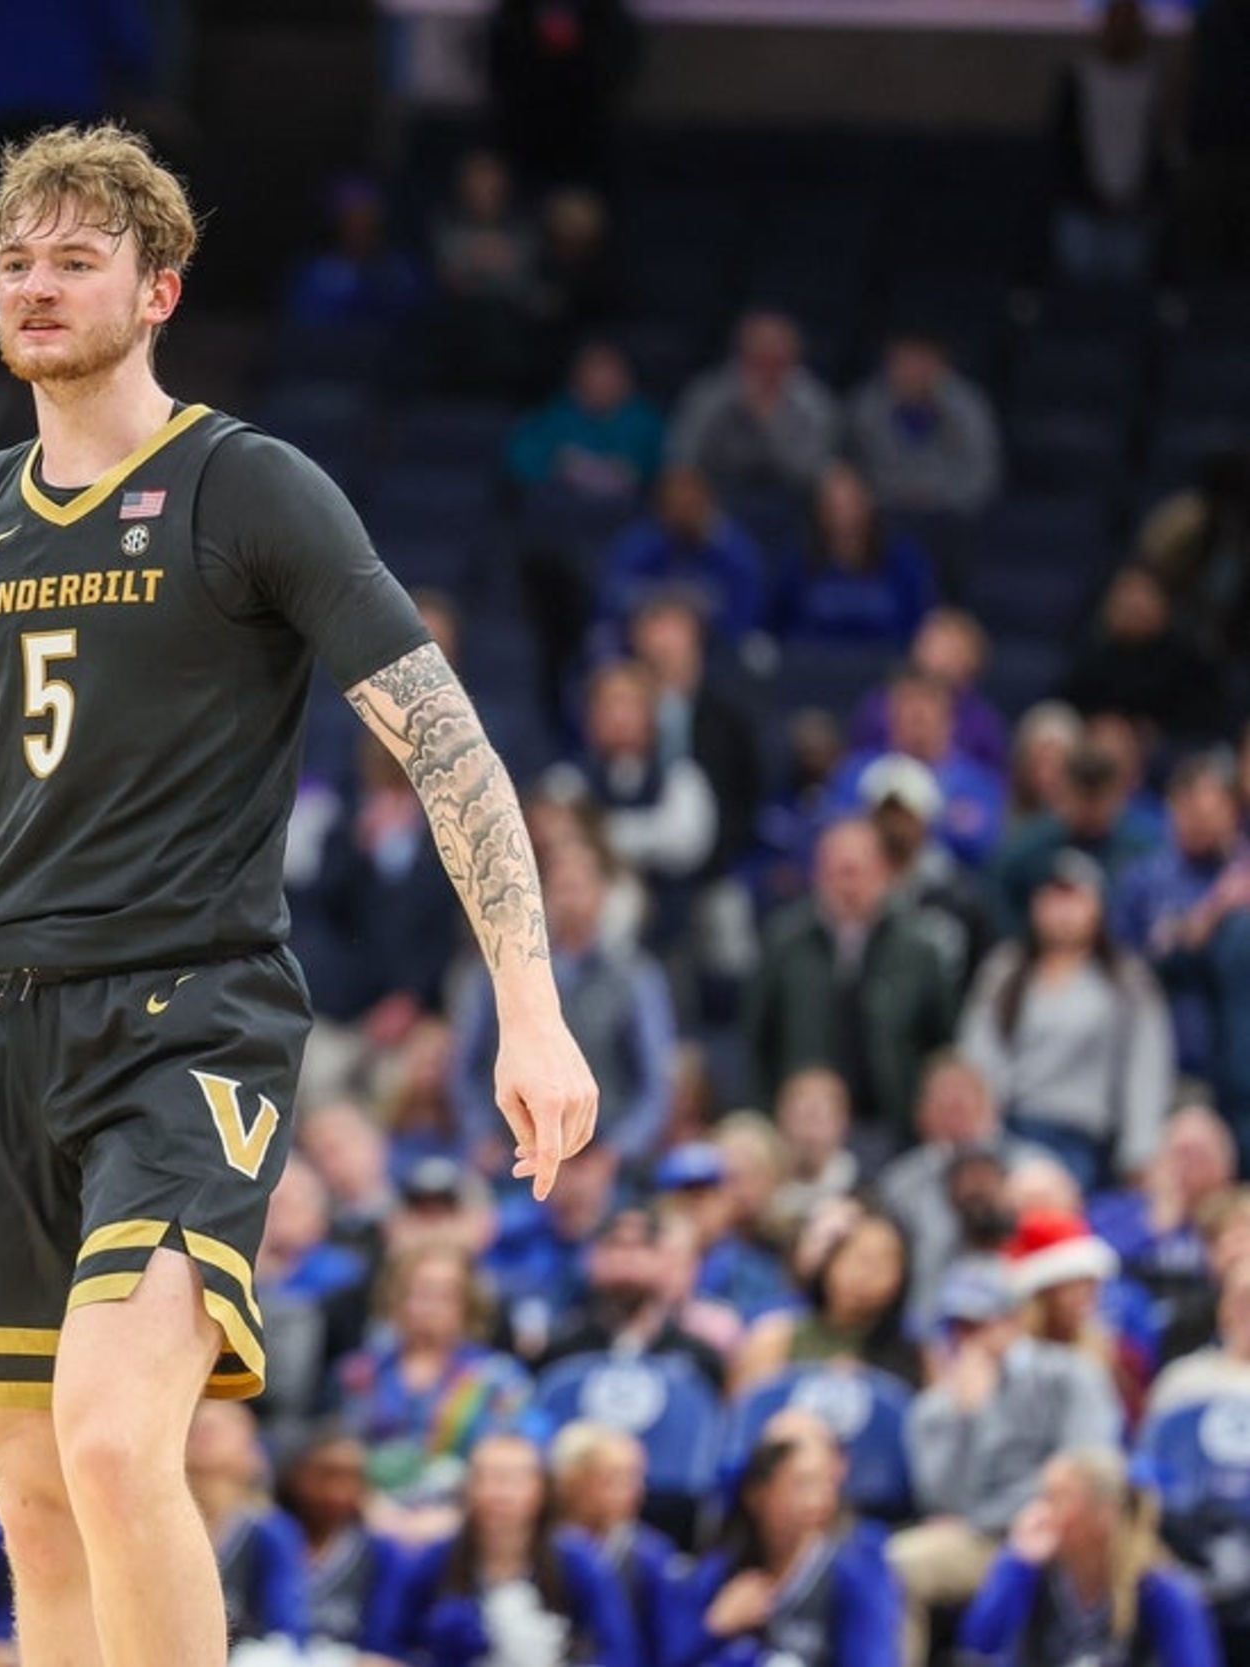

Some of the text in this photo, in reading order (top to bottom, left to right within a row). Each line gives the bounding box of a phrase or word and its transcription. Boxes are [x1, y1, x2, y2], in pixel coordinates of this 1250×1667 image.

[121, 524, 149, 556] SEC
[21, 627, 78, 779] 5
[188, 1068, 280, 1181] V
